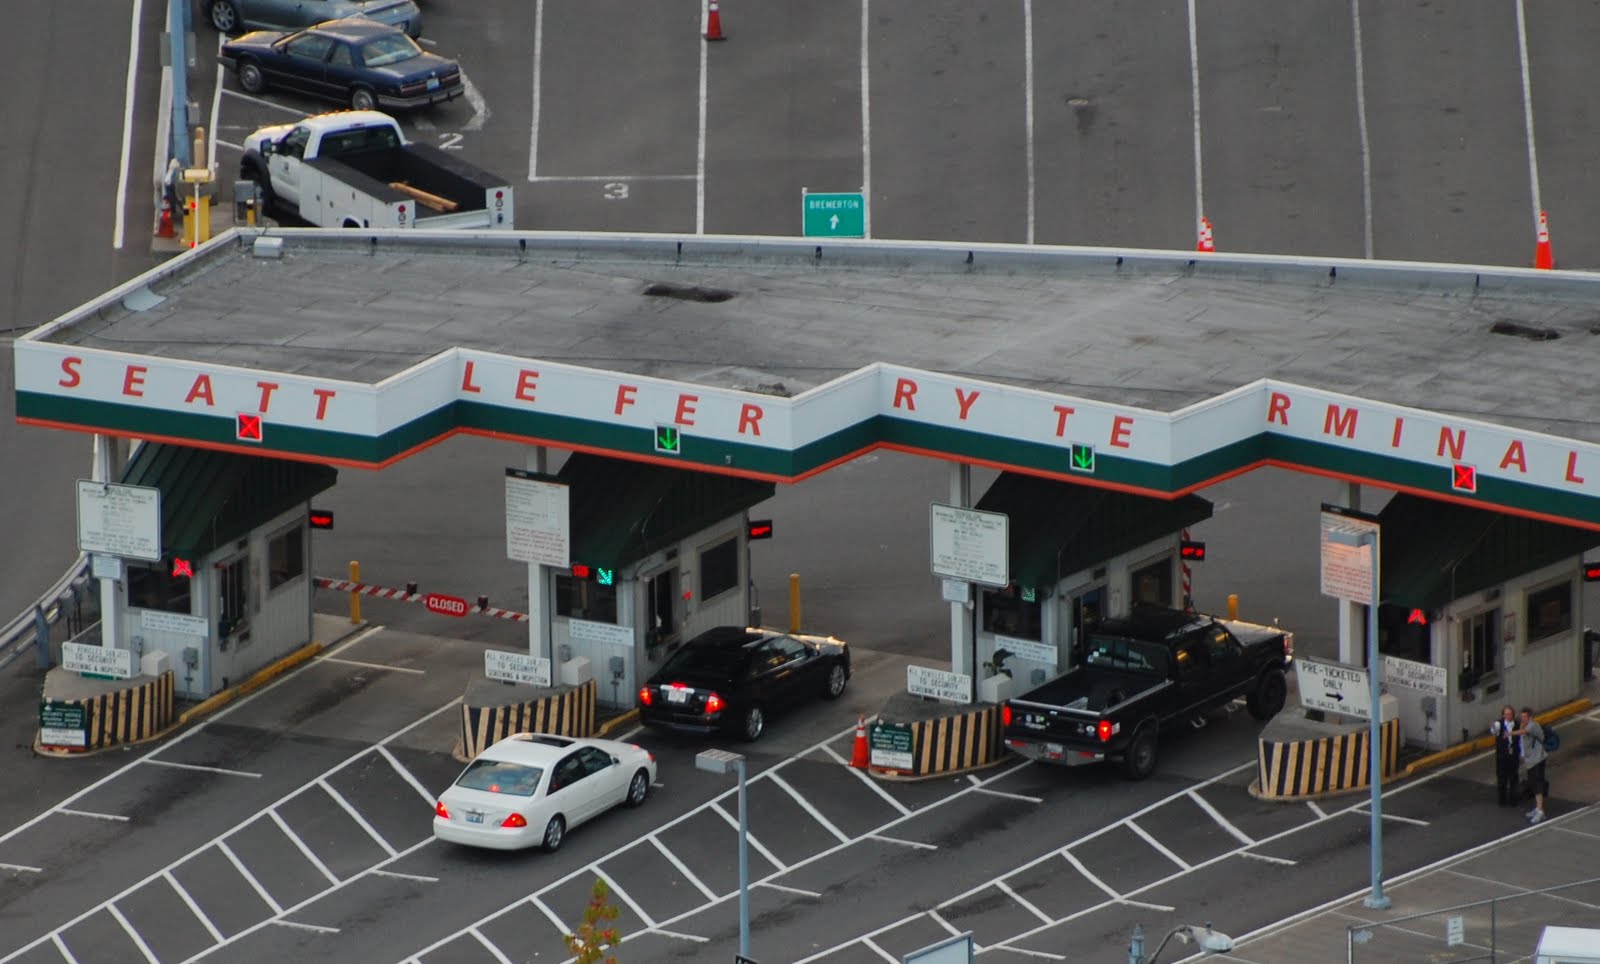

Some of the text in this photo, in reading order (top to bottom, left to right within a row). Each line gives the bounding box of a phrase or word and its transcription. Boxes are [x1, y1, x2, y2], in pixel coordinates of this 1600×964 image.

[439, 132, 464, 150] 2
[603, 182, 629, 200] 3
[809, 200, 859, 209] BREMERTON
[429, 596, 464, 613] CLOSED
[1302, 662, 1361, 683] PRE-TICKETED
[1322, 678, 1344, 691] ONLY
[1317, 700, 1335, 710] SALES
[1338, 703, 1351, 713] THIS
[1354, 707, 1368, 716] LANE
